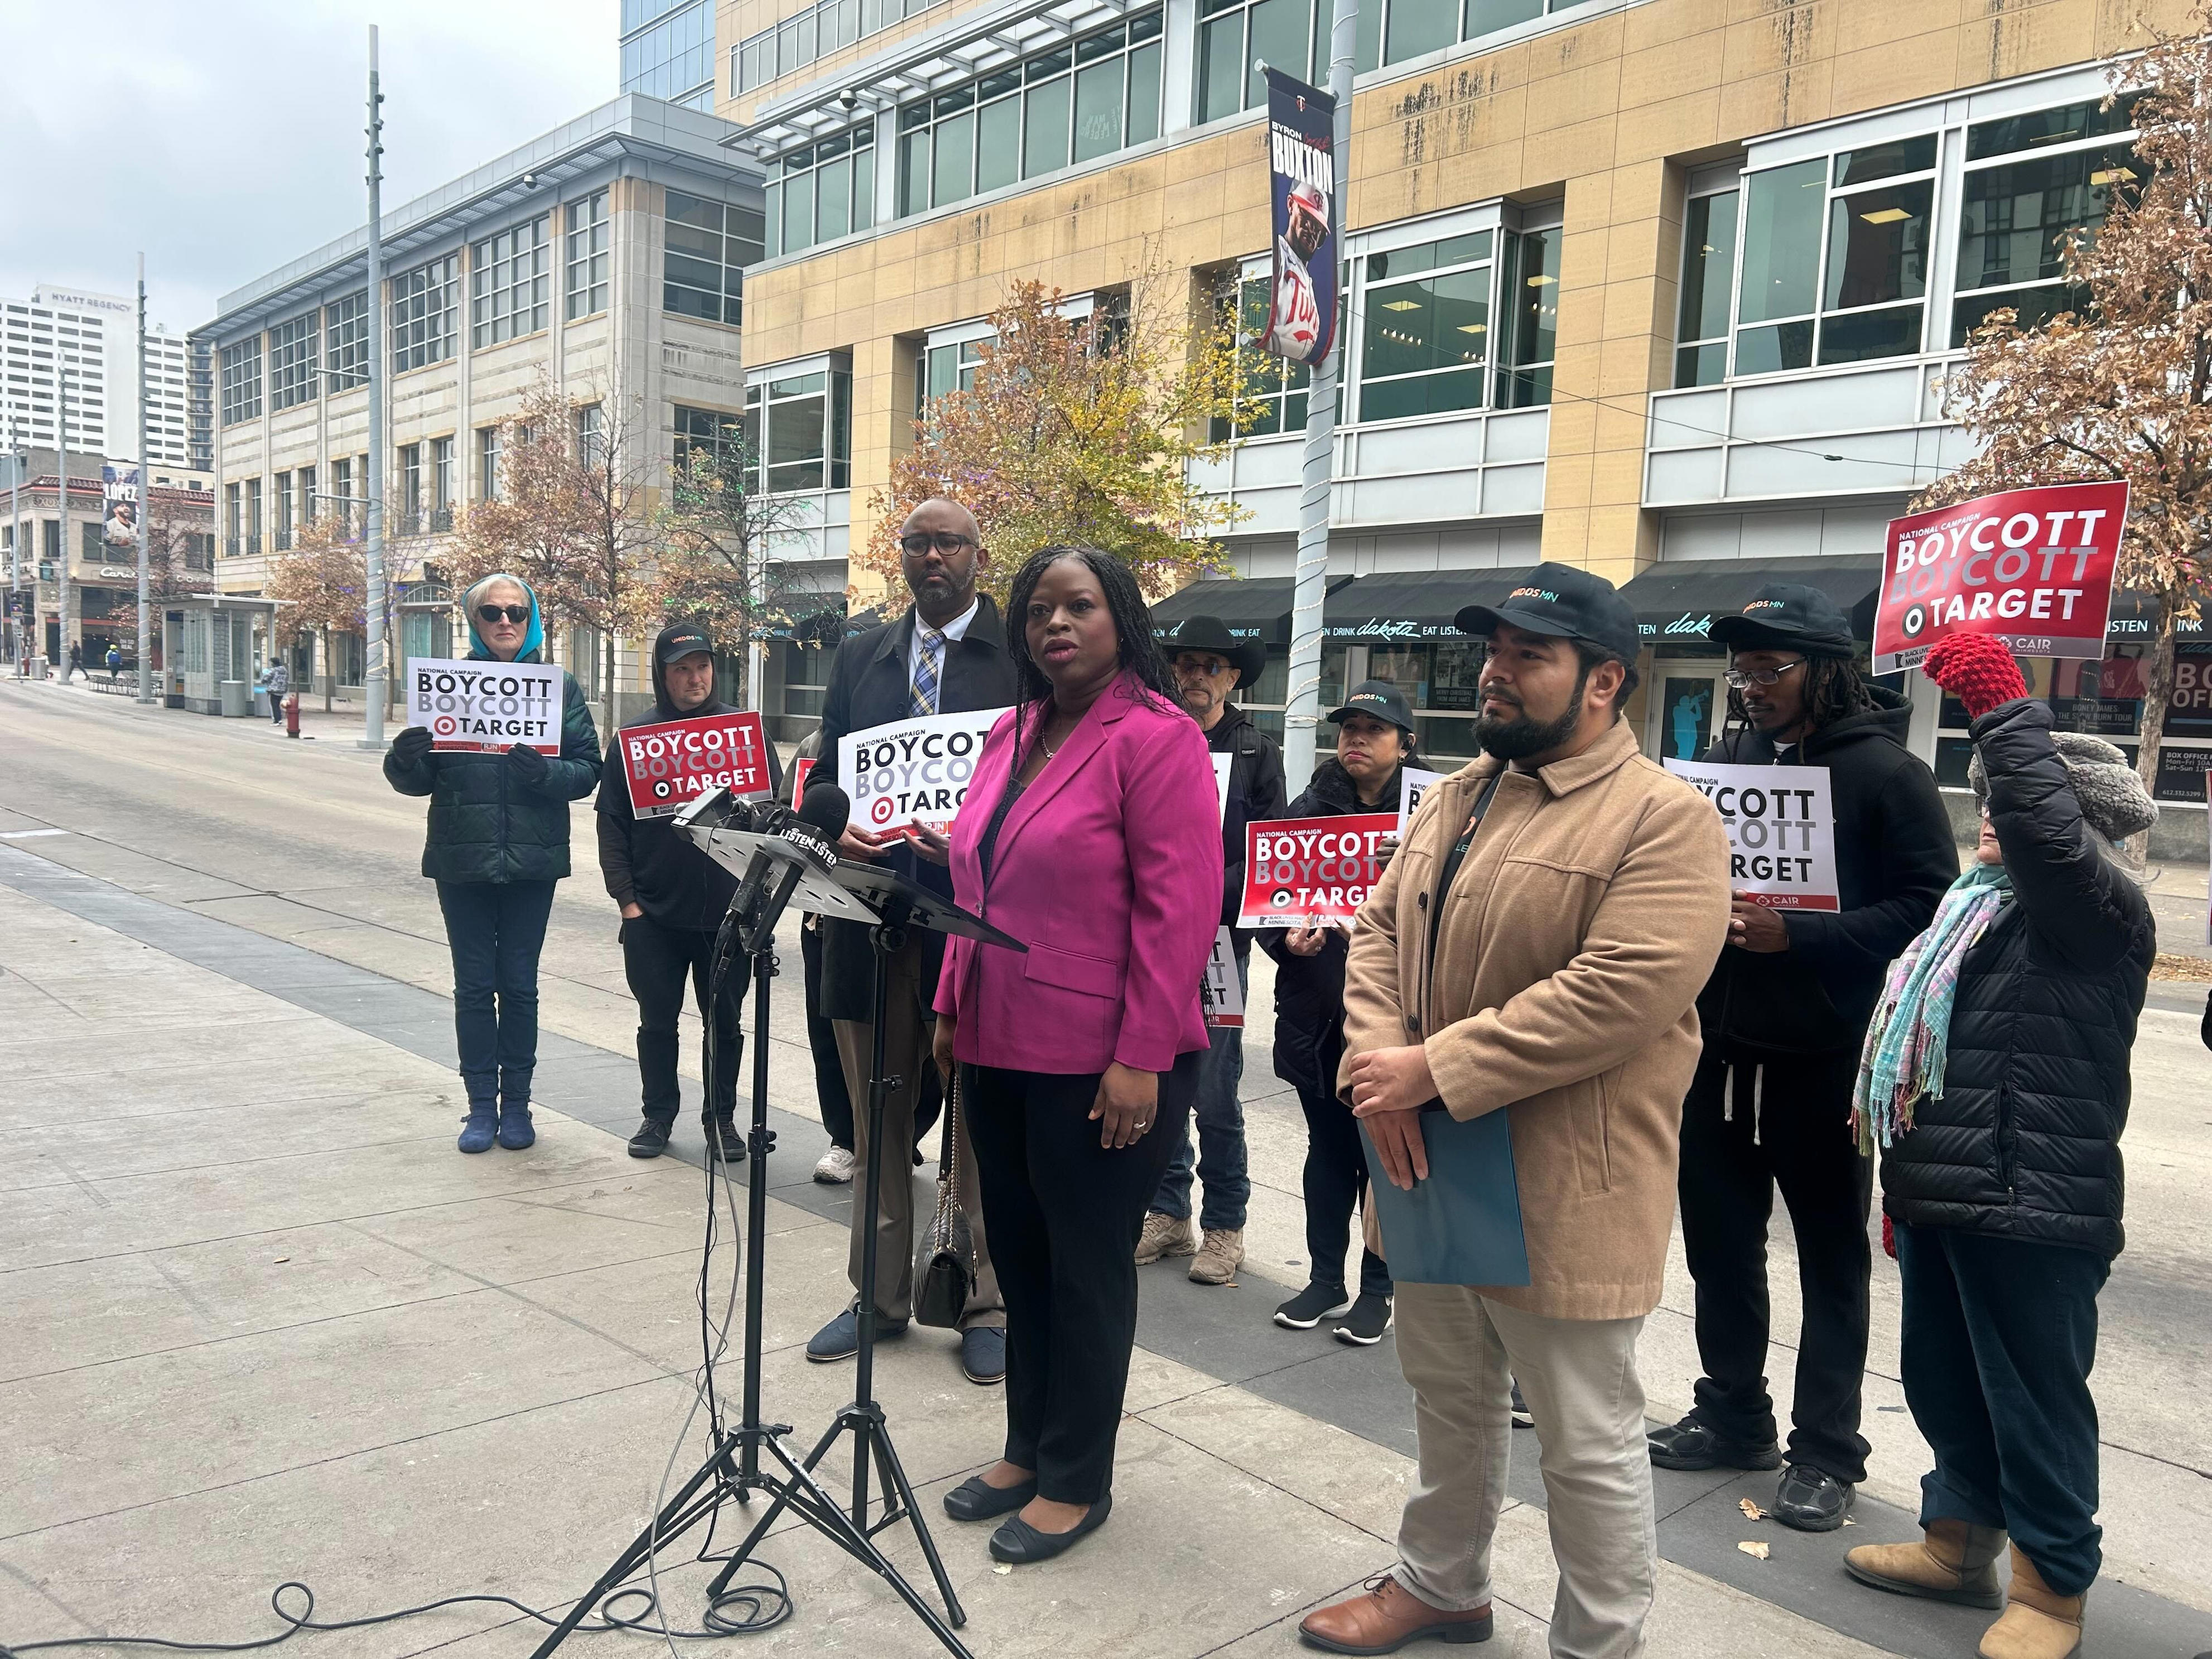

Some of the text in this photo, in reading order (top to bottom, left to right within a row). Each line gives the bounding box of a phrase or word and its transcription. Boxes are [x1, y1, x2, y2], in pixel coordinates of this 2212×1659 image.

[1272, 121, 1302, 141] BYRON
[1272, 130, 1333, 195] BUXTON
[52, 292, 131, 312] HYATT REGENCY
[1899, 513, 1980, 541] NATIONAL CAMPAIGN
[1895, 509, 2107, 574] BOYCOTT
[1889, 547, 2099, 605] BOYCOTT
[1930, 588, 2083, 628] TARGET
[1248, 629, 1260, 637] EAT
[1333, 627, 1356, 636] DRINK
[1357, 617, 1421, 641] dakota
[1423, 626, 1437, 635] EAT
[1638, 624, 1656, 635] TEN
[2016, 638, 2051, 649] CAIR
[418, 673, 552, 697] BOYCOTT
[418, 693, 552, 717] BOYCOTT
[459, 717, 548, 736] TARGET
[628, 729, 686, 742] NATIONAL CAMPAIGN
[629, 726, 753, 761] BOYCOTT
[856, 729, 926, 749] NATIONAL CAMPAIGN
[633, 745, 755, 780] BOYCOTT
[672, 768, 756, 794] TARGET
[855, 757, 973, 799] BOYCO
[1410, 782, 1427, 791] NATIO
[1690, 777, 1718, 785] CAMPAIGN
[779, 828, 816, 847] LISTEN
[926, 822, 944, 831] RJN
[1255, 856, 1377, 885] BOYCOT
[1731, 853, 1813, 882] RGET
[1772, 896, 1799, 905] CAIR
